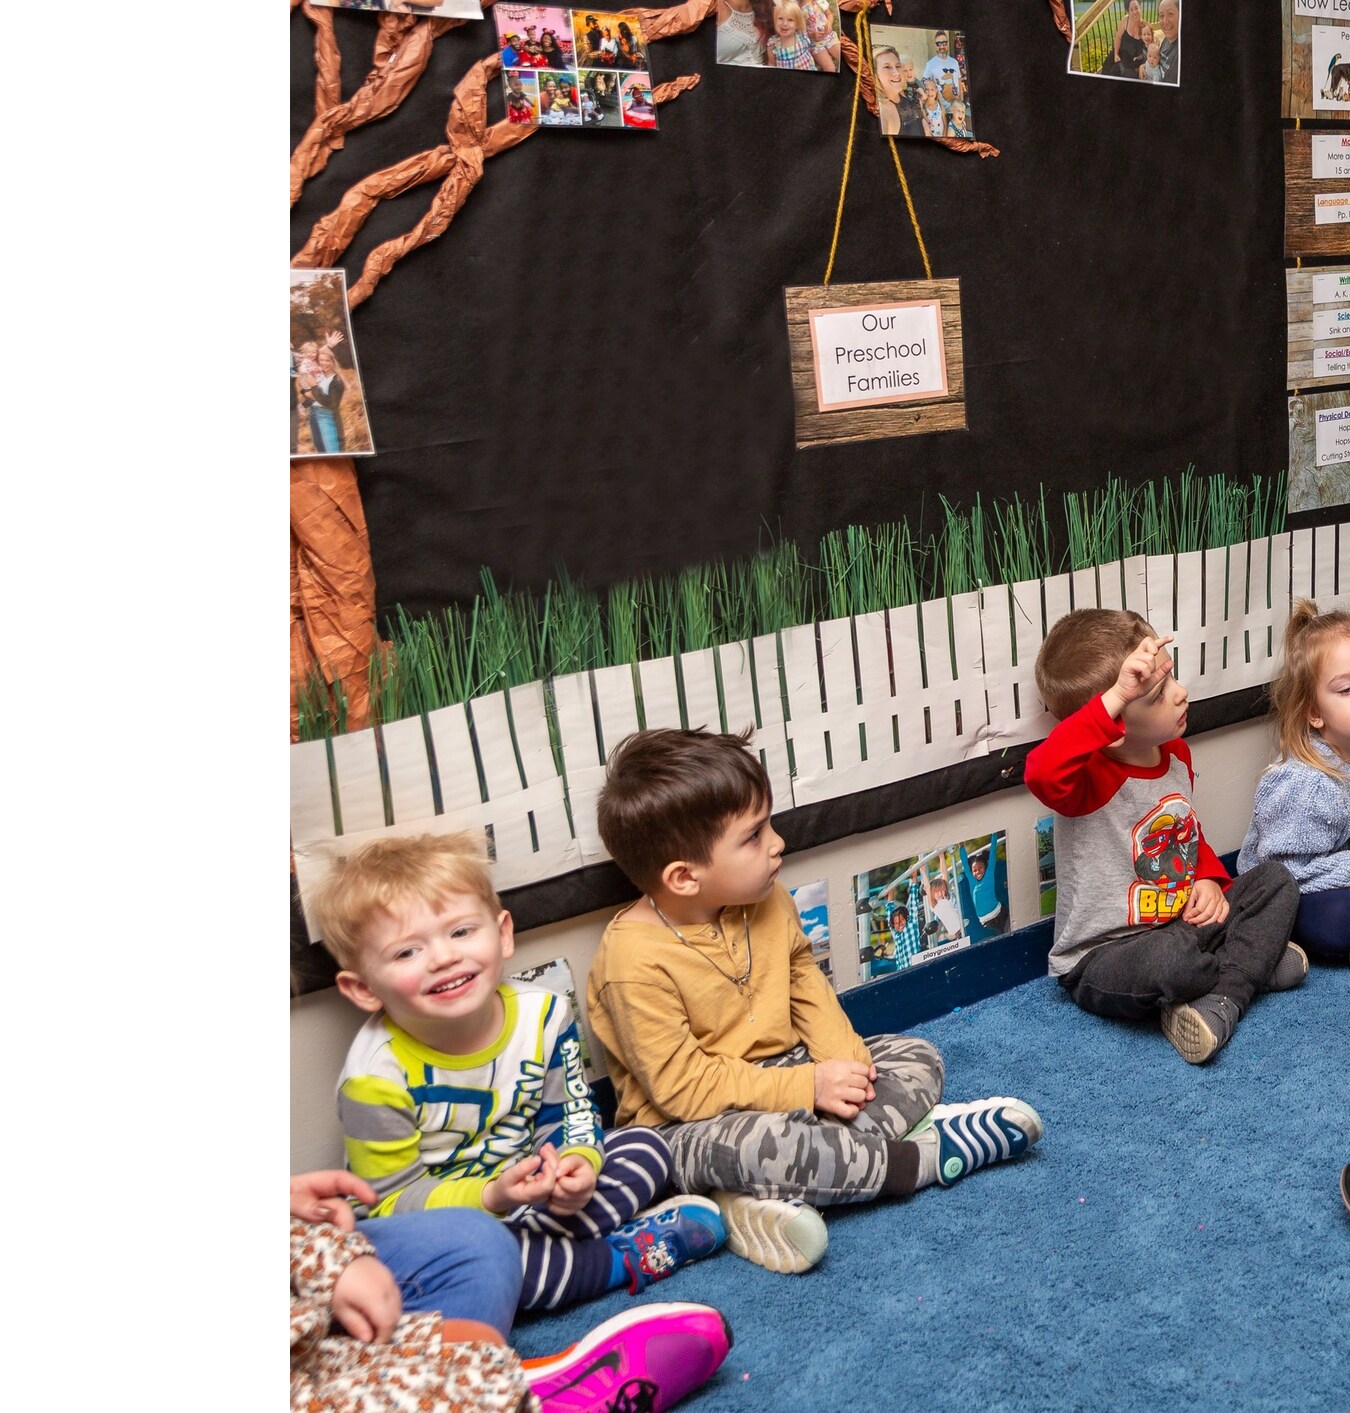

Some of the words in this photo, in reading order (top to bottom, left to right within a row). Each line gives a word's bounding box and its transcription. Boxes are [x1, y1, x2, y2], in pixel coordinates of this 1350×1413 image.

[1318, 198, 1348, 207] Language
[862, 314, 896, 332] Our
[835, 338, 927, 364] Preschool
[1328, 363, 1346, 372] Telling
[847, 370, 920, 392] Families
[1319, 411, 1344, 422] Physical
[1322, 452, 1343, 462] Cutting
[1139, 888, 1192, 921] BLA
[923, 942, 959, 960] playground
[560, 1038, 590, 1099] AND
